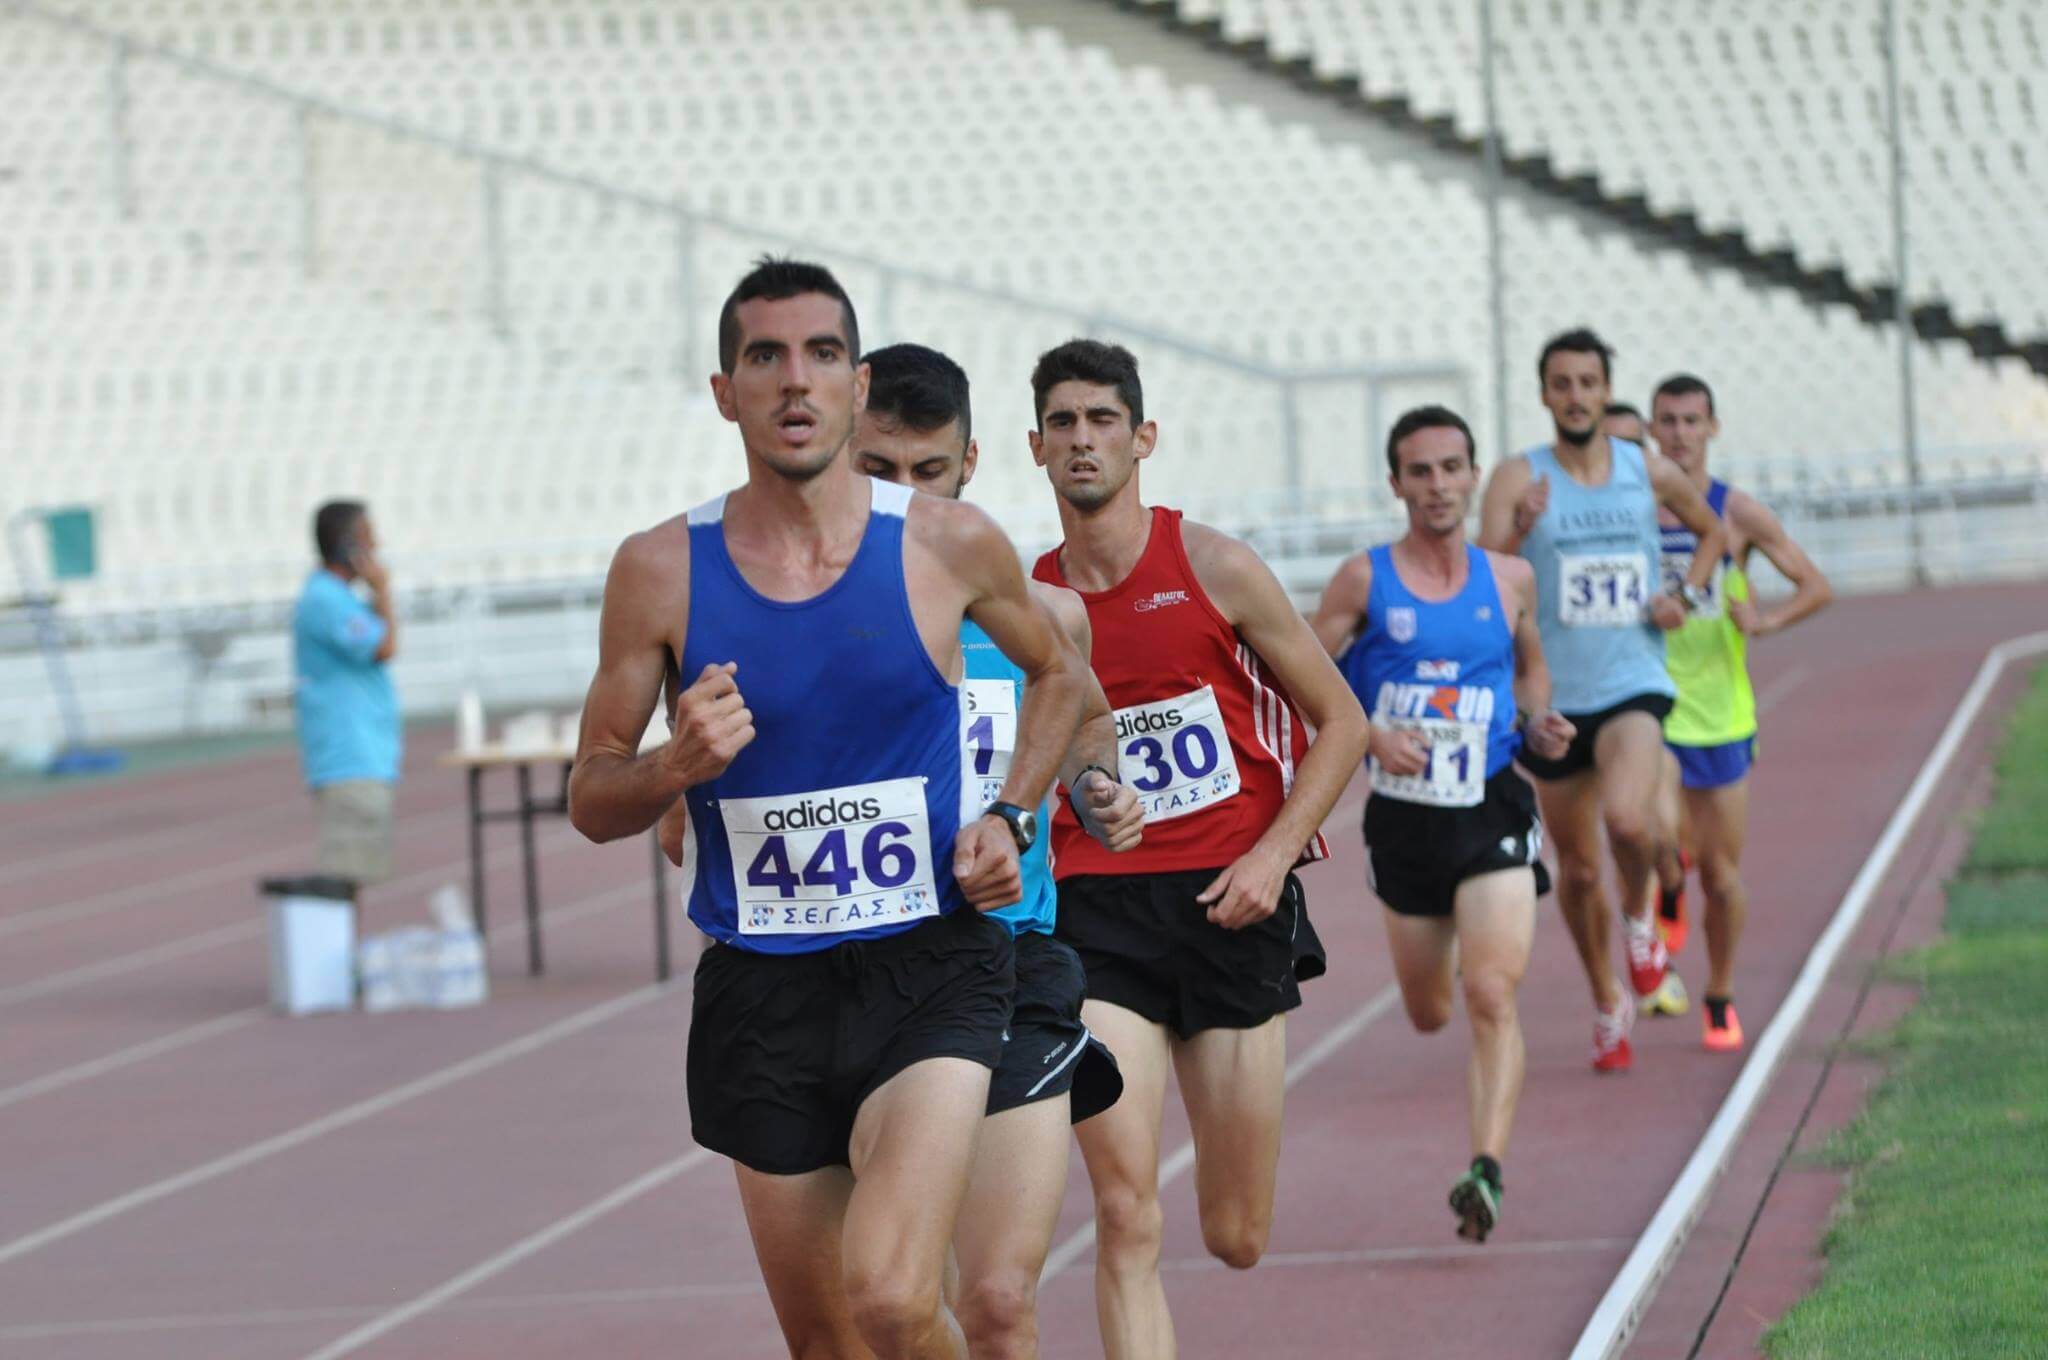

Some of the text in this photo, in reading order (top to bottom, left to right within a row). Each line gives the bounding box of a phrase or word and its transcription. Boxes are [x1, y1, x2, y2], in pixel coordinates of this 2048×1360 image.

[1569, 574, 1641, 608] 314
[1113, 706, 1183, 739] didas
[1117, 723, 1219, 792] 30
[763, 796, 881, 831] adidas
[746, 821, 917, 898] 446
